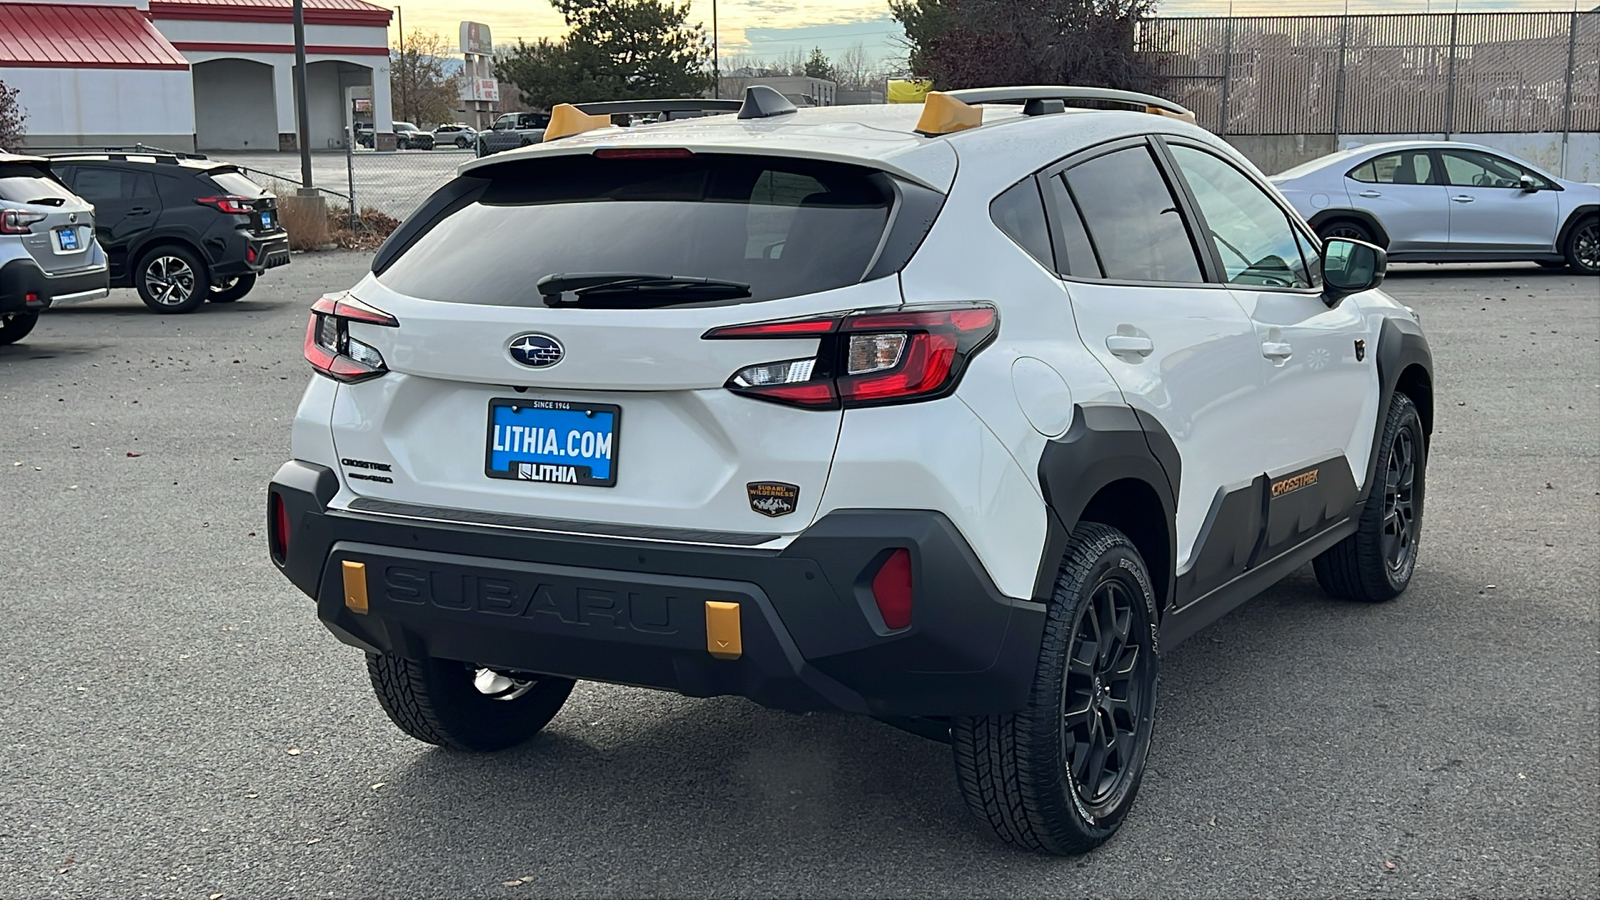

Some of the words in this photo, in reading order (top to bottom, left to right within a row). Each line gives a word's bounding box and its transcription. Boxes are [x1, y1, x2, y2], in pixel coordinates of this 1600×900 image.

[533, 401, 553, 409] SINCE
[555, 402, 570, 410] 1946
[493, 424, 612, 460] LITHIA.COM
[341, 458, 392, 472] CROSSTREK
[531, 463, 578, 483] LITHIA
[1271, 469, 1319, 497] CROSSTREK
[750, 489, 794, 498] WILDERNESS
[384, 565, 679, 635] SUBARU
